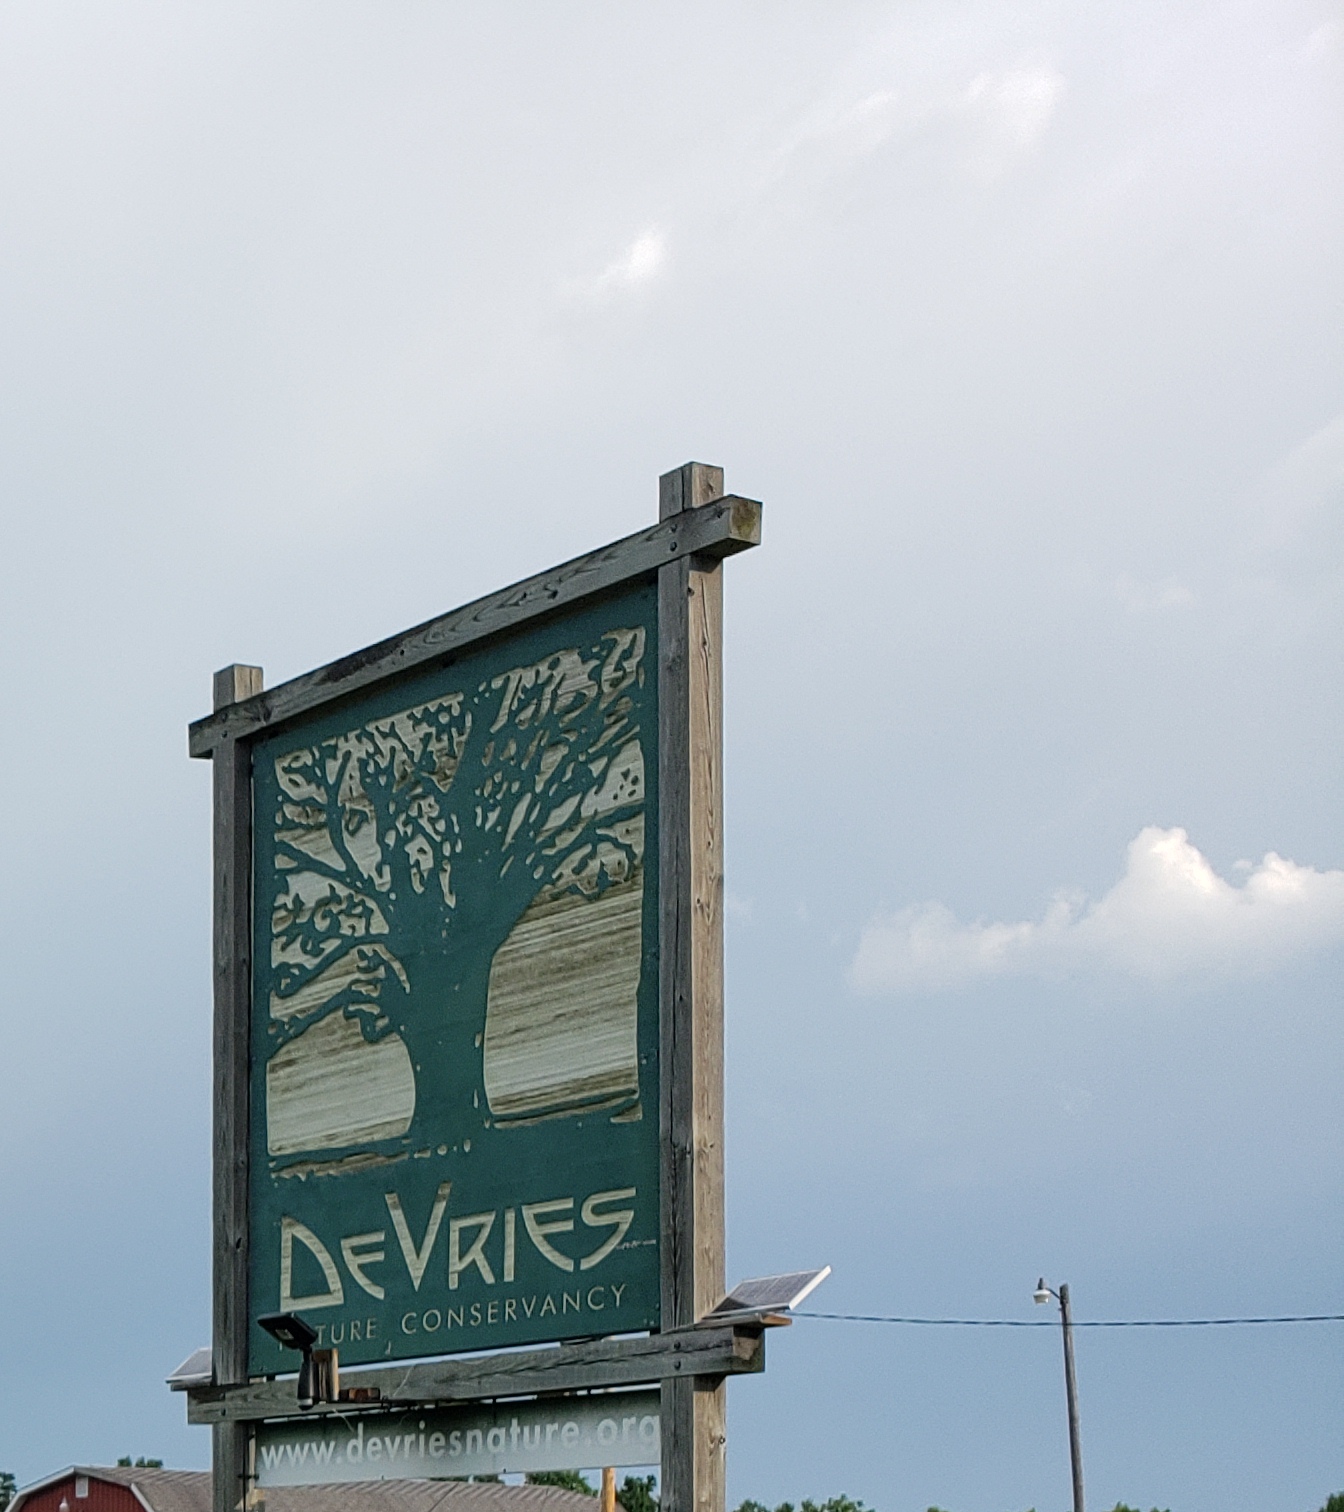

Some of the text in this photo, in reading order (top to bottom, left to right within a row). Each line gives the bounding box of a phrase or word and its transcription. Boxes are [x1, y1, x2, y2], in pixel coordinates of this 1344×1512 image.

[278, 1284, 627, 1352] TURE CONSERVANCY
[260, 1412, 660, 1471] www.devriesnature.org
